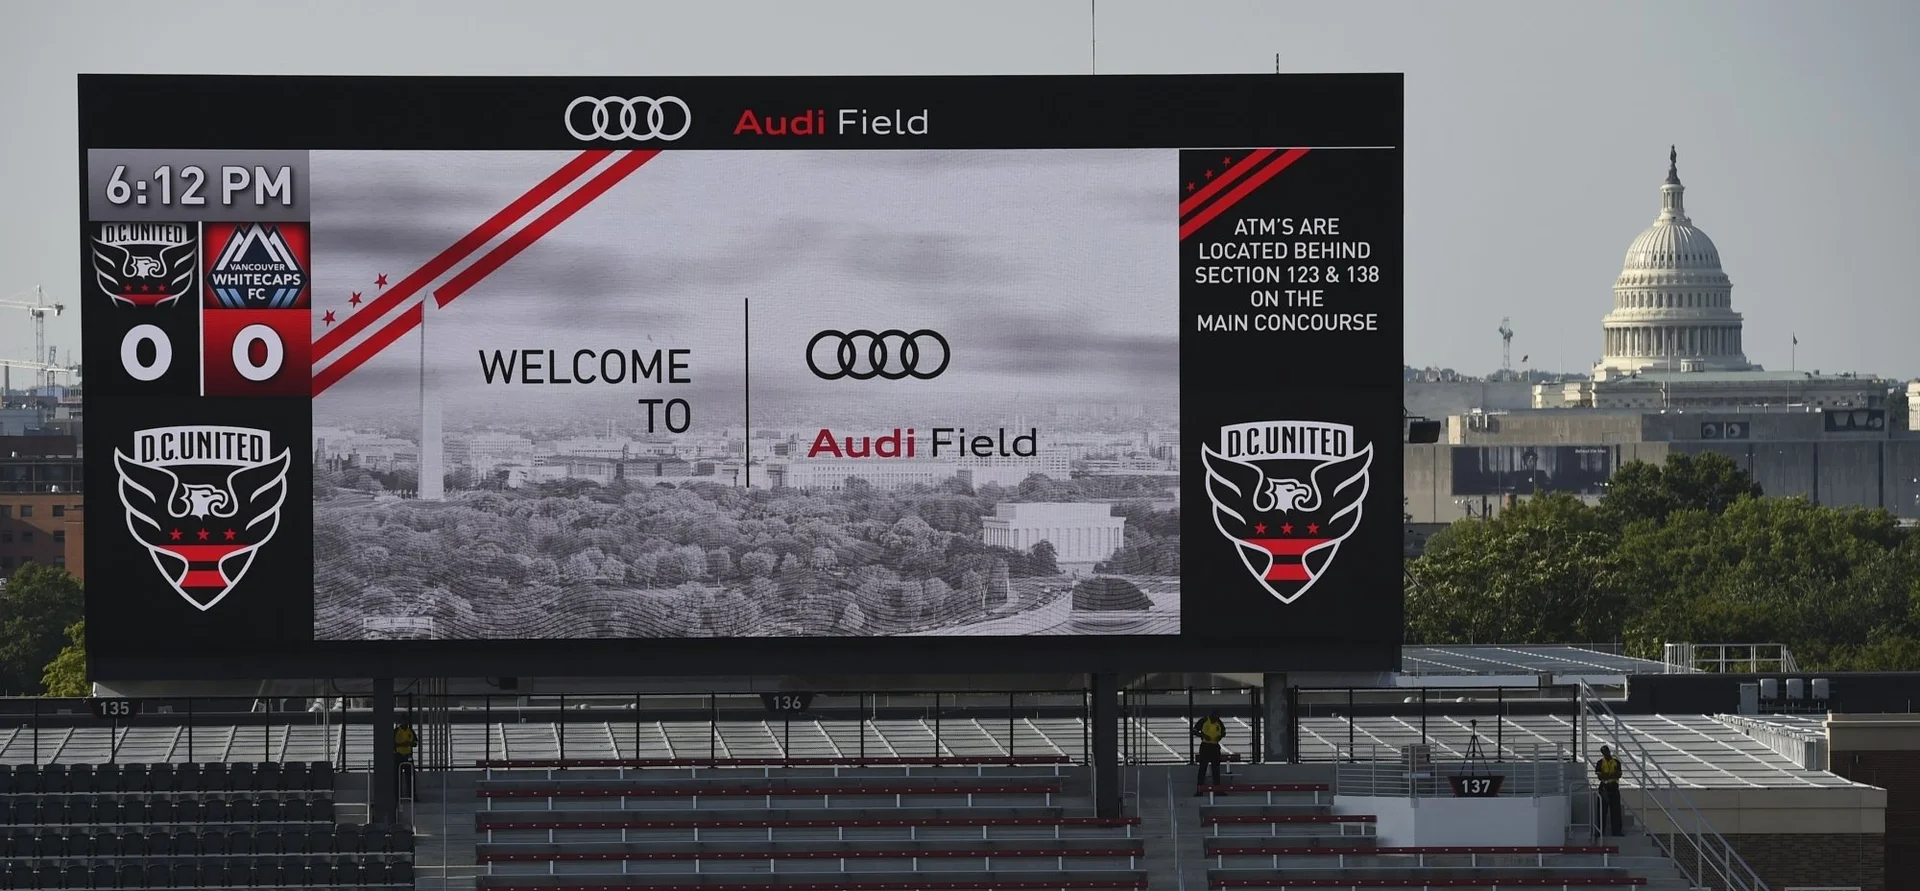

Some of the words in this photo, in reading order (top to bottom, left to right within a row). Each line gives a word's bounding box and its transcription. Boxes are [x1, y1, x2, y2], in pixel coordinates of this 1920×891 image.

[733, 108, 826, 136] Audi
[838, 108, 929, 136] Field
[105, 165, 206, 206] 6:12
[221, 165, 292, 206] PM
[1234, 218, 1294, 236] ATM'S
[1299, 217, 1340, 235] ARE
[1199, 242, 1288, 260] LOCATED
[1294, 241, 1371, 259] BEHIND
[229, 263, 285, 272] VANCOUVER
[1195, 266, 1280, 284] SECTION
[1287, 265, 1320, 283] 123
[1325, 265, 1340, 283] &
[1347, 265, 1380, 283] 138
[212, 273, 301, 286] WHITECAPS
[248, 288, 266, 300] FC
[1250, 290, 1279, 307] ON
[1284, 289, 1324, 307] THE
[1197, 314, 1248, 332] MAIN
[1254, 313, 1378, 331] CONCOURSE
[120, 323, 173, 381] 0
[231, 323, 284, 381] 0
[478, 349, 692, 385] WELCOME
[638, 398, 691, 434] TO
[807, 428, 915, 458] Audi
[931, 427, 1037, 458] Field
[100, 701, 130, 715] 135
[773, 695, 802, 710] 136
[1461, 779, 1491, 793] 137
